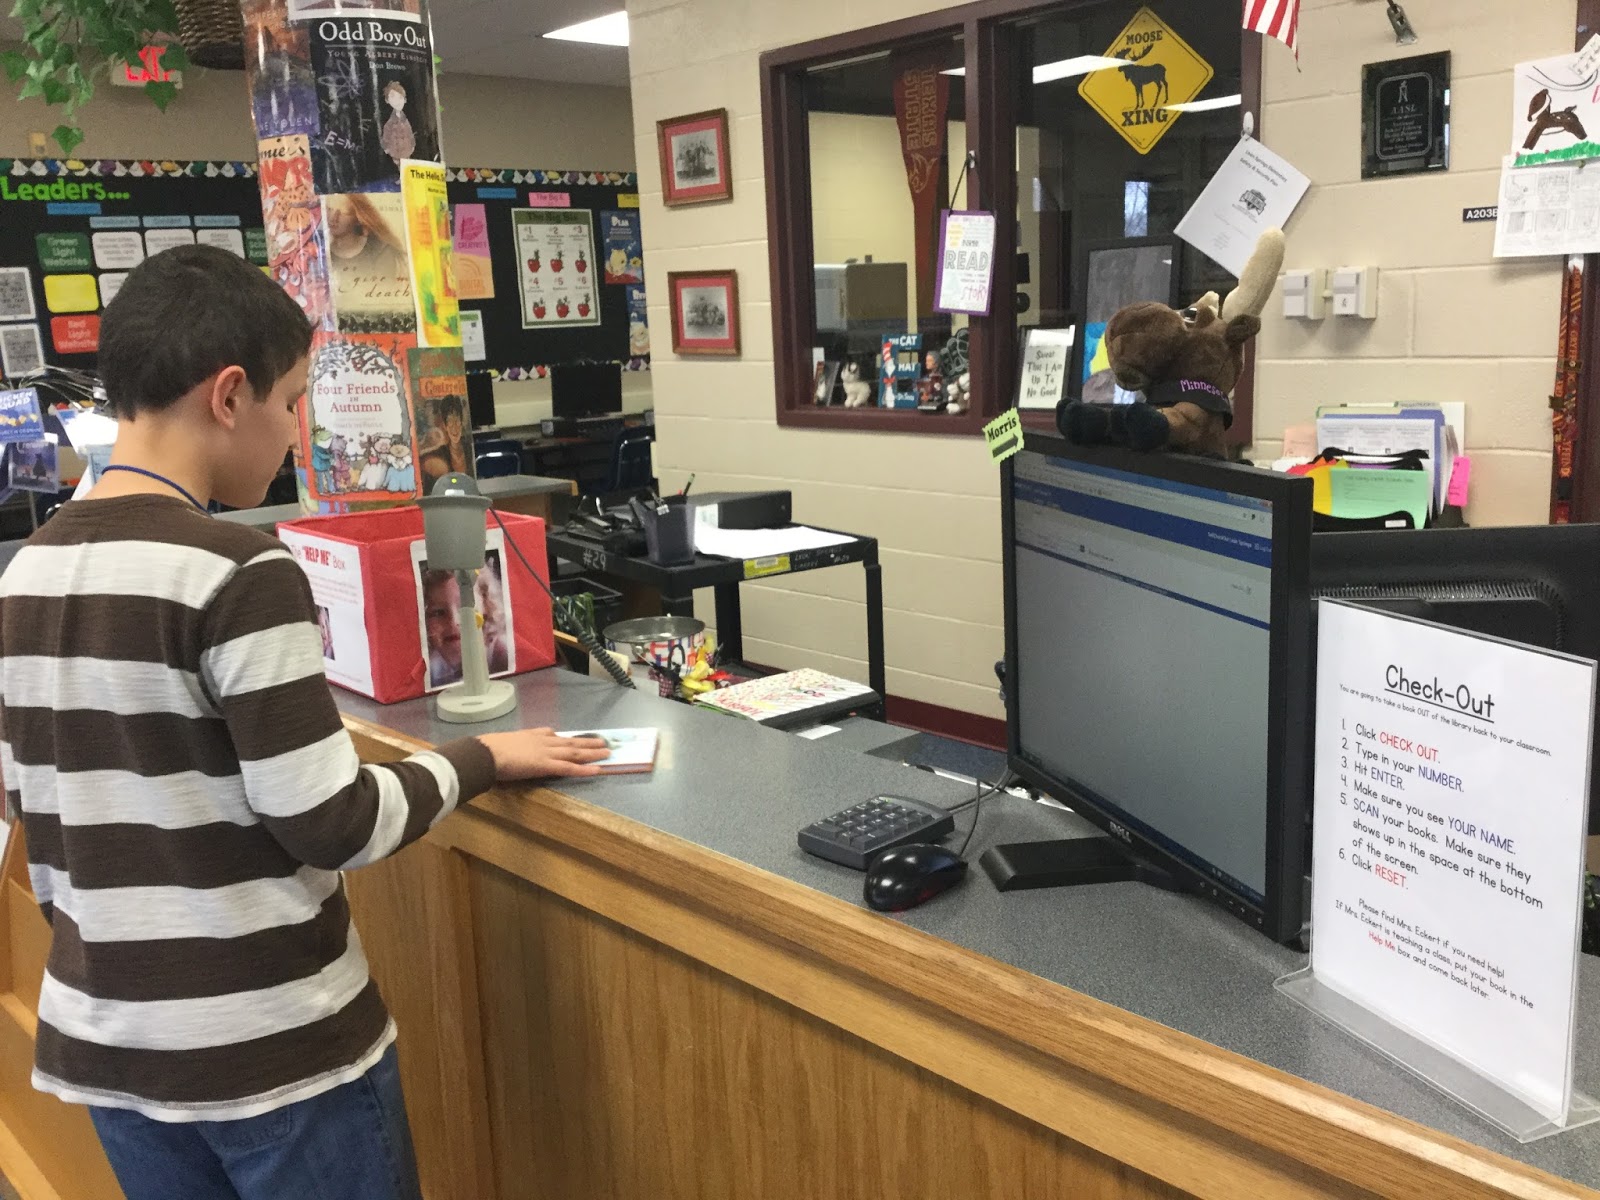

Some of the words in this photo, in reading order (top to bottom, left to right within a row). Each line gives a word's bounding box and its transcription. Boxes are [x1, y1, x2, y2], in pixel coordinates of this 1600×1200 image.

[319, 21, 364, 41] Odd
[368, 22, 402, 46] Boy
[404, 26, 426, 48] Out
[1126, 30, 1163, 45] MOOSE
[1122, 108, 1168, 127] XING
[410, 169, 424, 179] The
[944, 250, 989, 270] READ
[365, 283, 410, 298] death
[900, 336, 918, 346] CAT
[898, 363, 916, 372] HAT
[1031, 375, 1040, 386] Up
[316, 384, 342, 394] Four
[346, 382, 396, 394] Friends
[1040, 386, 1057, 398] Good
[1180, 379, 1230, 405] Minneso
[330, 402, 382, 412] Autumn
[987, 417, 1017, 443] Morris
[1386, 664, 1495, 718] Check-Out
[1340, 684, 1349, 692] You
[1360, 693, 1374, 702] going
[1384, 698, 1396, 707] take
[1402, 703, 1415, 712] book
[1417, 708, 1430, 716] OUT
[1441, 716, 1450, 724] the
[1452, 719, 1472, 732] library
[1473, 725, 1488, 736] back
[1490, 731, 1497, 739] to
[1499, 736, 1515, 745] your
[1516, 739, 1552, 756] classroom.
[1356, 723, 1376, 741] Click
[1380, 732, 1413, 753] CHECK
[1417, 744, 1440, 764] OUT.
[1342, 737, 1348, 750] 2.
[1355, 741, 1378, 762] Type
[1382, 754, 1389, 765] in
[1392, 759, 1415, 774] your
[1418, 764, 1464, 792] NUMBER.
[1342, 756, 1348, 768] 3.
[1354, 761, 1368, 776] Hit
[1371, 766, 1404, 790] ENTER.
[1341, 774, 1348, 787] 4.
[1354, 779, 1378, 799] Make
[1381, 795, 1402, 808] sure
[1406, 804, 1423, 817] you
[1427, 813, 1444, 825] see
[1448, 816, 1476, 838] YOUR
[1480, 829, 1516, 855] NAME.
[1340, 792, 1347, 805] 5.
[1354, 798, 1379, 818] SCAN
[1382, 814, 1404, 828] your
[1408, 820, 1438, 843] books.
[1446, 835, 1473, 858] Make
[1478, 853, 1501, 869] sure
[1506, 862, 1531, 885] they
[1339, 848, 1346, 860] 6.
[1352, 854, 1372, 872] Click
[1375, 864, 1408, 889] RESET.
[1352, 838, 1363, 848] of
[1366, 842, 1381, 858] the
[1384, 854, 1418, 874] screen.
[1353, 818, 1380, 838] shows
[1384, 834, 1394, 846] up
[1398, 838, 1406, 850] in
[1409, 842, 1425, 858] the
[1429, 854, 1459, 872] space
[1463, 867, 1475, 878] at
[1479, 870, 1496, 888] the
[1500, 879, 1542, 909] bottom
[1359, 898, 1379, 916] Please
[1382, 910, 1395, 924] find
[1397, 918, 1412, 932] Mrs.
[1415, 926, 1440, 944] Eckert
[1443, 940, 1449, 948] if
[1452, 947, 1465, 957] you
[1468, 954, 1485, 968] need
[1488, 962, 1504, 978] help!
[1336, 900, 1343, 909] If
[1345, 905, 1358, 918] Mrs.
[1361, 912, 1382, 930] Eckert
[1392, 930, 1423, 952] teaching
[1432, 950, 1452, 966] class,
[1455, 962, 1467, 972] put
[1470, 970, 1487, 982] your
[1490, 978, 1507, 995] book
[1510, 991, 1516, 1000] in
[1520, 995, 1533, 1008] the
[1369, 931, 1383, 945] Help
[1385, 940, 1395, 951] Me
[1398, 945, 1410, 958] box
[1413, 956, 1426, 966] and
[1429, 964, 1448, 977] come
[1451, 971, 1468, 987] back
[1470, 982, 1490, 1000] later.
